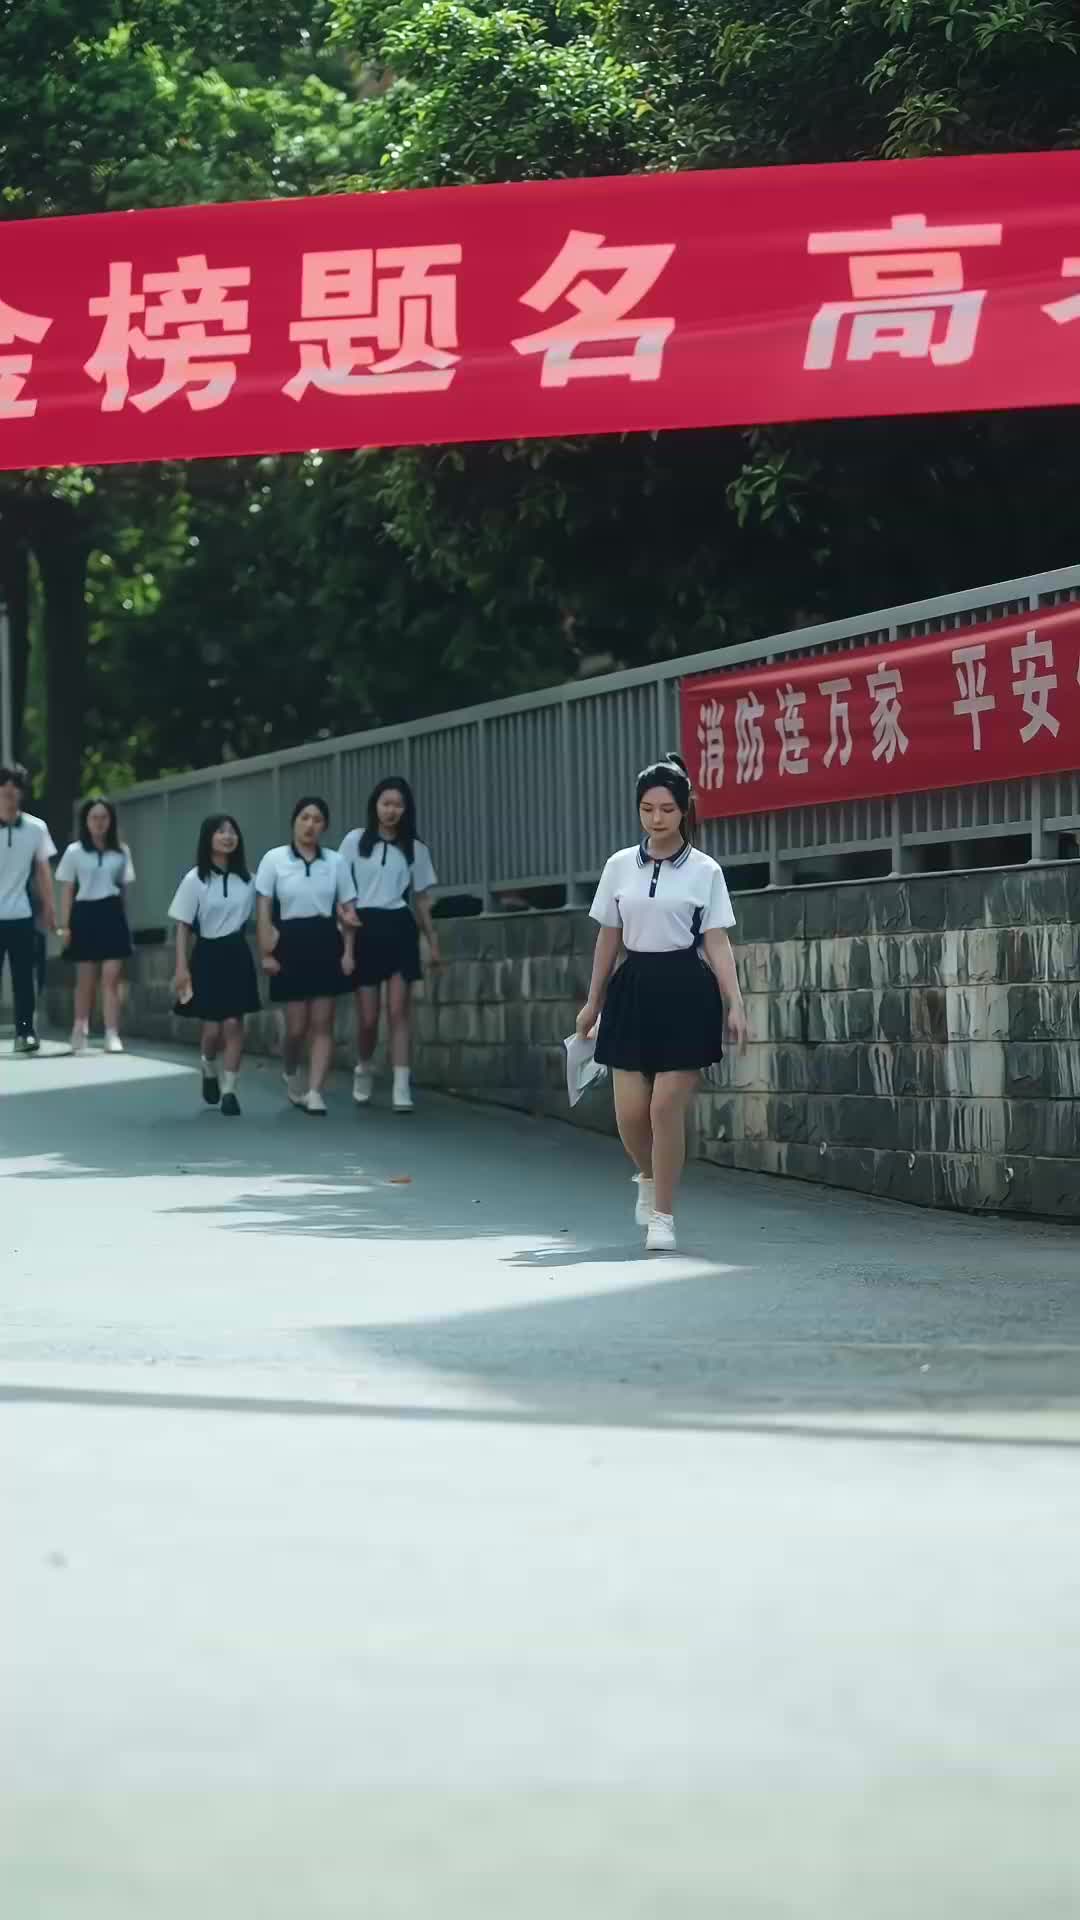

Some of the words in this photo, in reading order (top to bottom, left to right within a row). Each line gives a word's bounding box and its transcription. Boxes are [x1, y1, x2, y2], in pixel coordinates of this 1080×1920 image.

[803, 213, 1080, 371] 高
[697, 661, 909, 790] 消防连万家
[951, 630, 1080, 752] 平安
